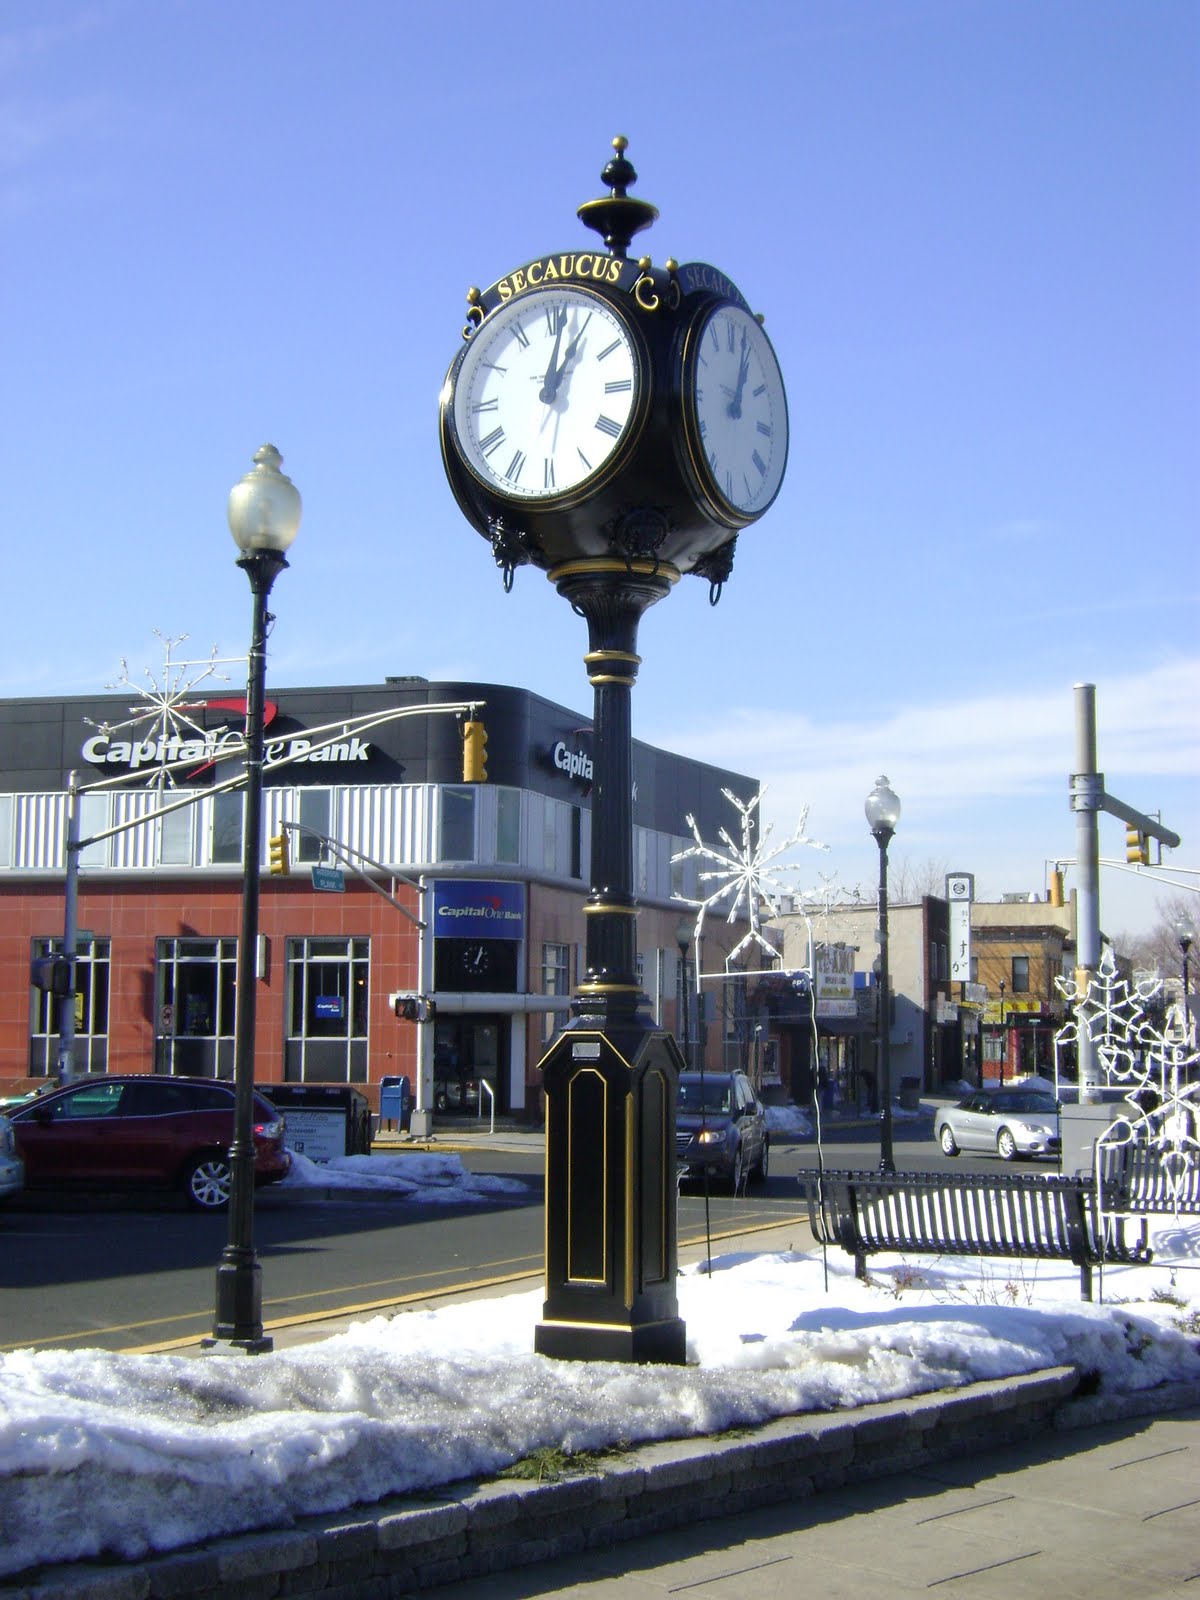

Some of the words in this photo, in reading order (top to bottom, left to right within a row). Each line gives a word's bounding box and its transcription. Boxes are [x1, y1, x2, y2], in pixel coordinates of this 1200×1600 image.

[497, 254, 623, 302] SECAUCUS
[82, 732, 217, 767] Capital
[289, 738, 370, 763] Bank
[554, 741, 594, 780] Capita
